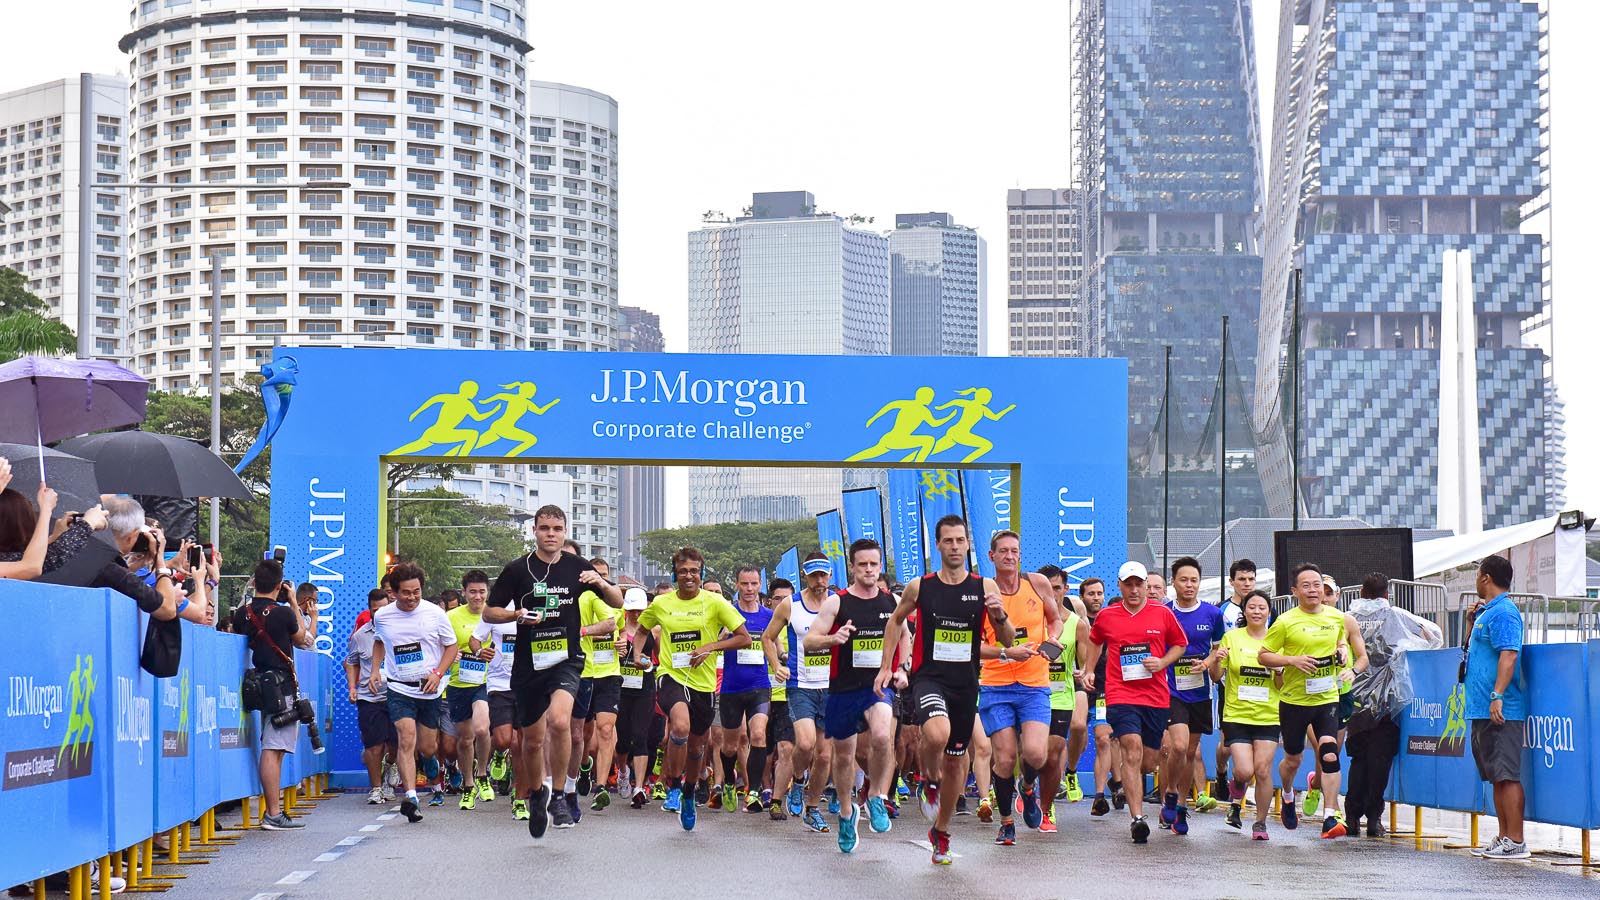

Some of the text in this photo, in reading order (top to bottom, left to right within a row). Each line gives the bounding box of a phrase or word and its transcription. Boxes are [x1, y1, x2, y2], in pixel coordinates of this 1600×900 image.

[590, 369, 808, 417] J.P.Morgan
[592, 421, 697, 441] Corporate
[308, 477, 346, 658] J.P.Morg
[534, 585, 570, 594] Breaking
[941, 620, 968, 628] J.P.Morgan
[941, 632, 967, 642] 9103
[536, 641, 562, 652] 9485
[676, 642, 697, 652] 5196
[859, 640, 883, 650] 9107
[396, 653, 421, 664] 10928
[808, 656, 830, 666] 6682
[461, 662, 484, 672] 14602
[622, 668, 640, 676] 3379
[1244, 678, 1265, 687] 4957
[7, 676, 63, 729] J.P.Morgan
[1410, 698, 1442, 727] J.P.Morgan
[116, 675, 150, 766] J.P.Morgan
[8, 759, 33, 781] Corporate
